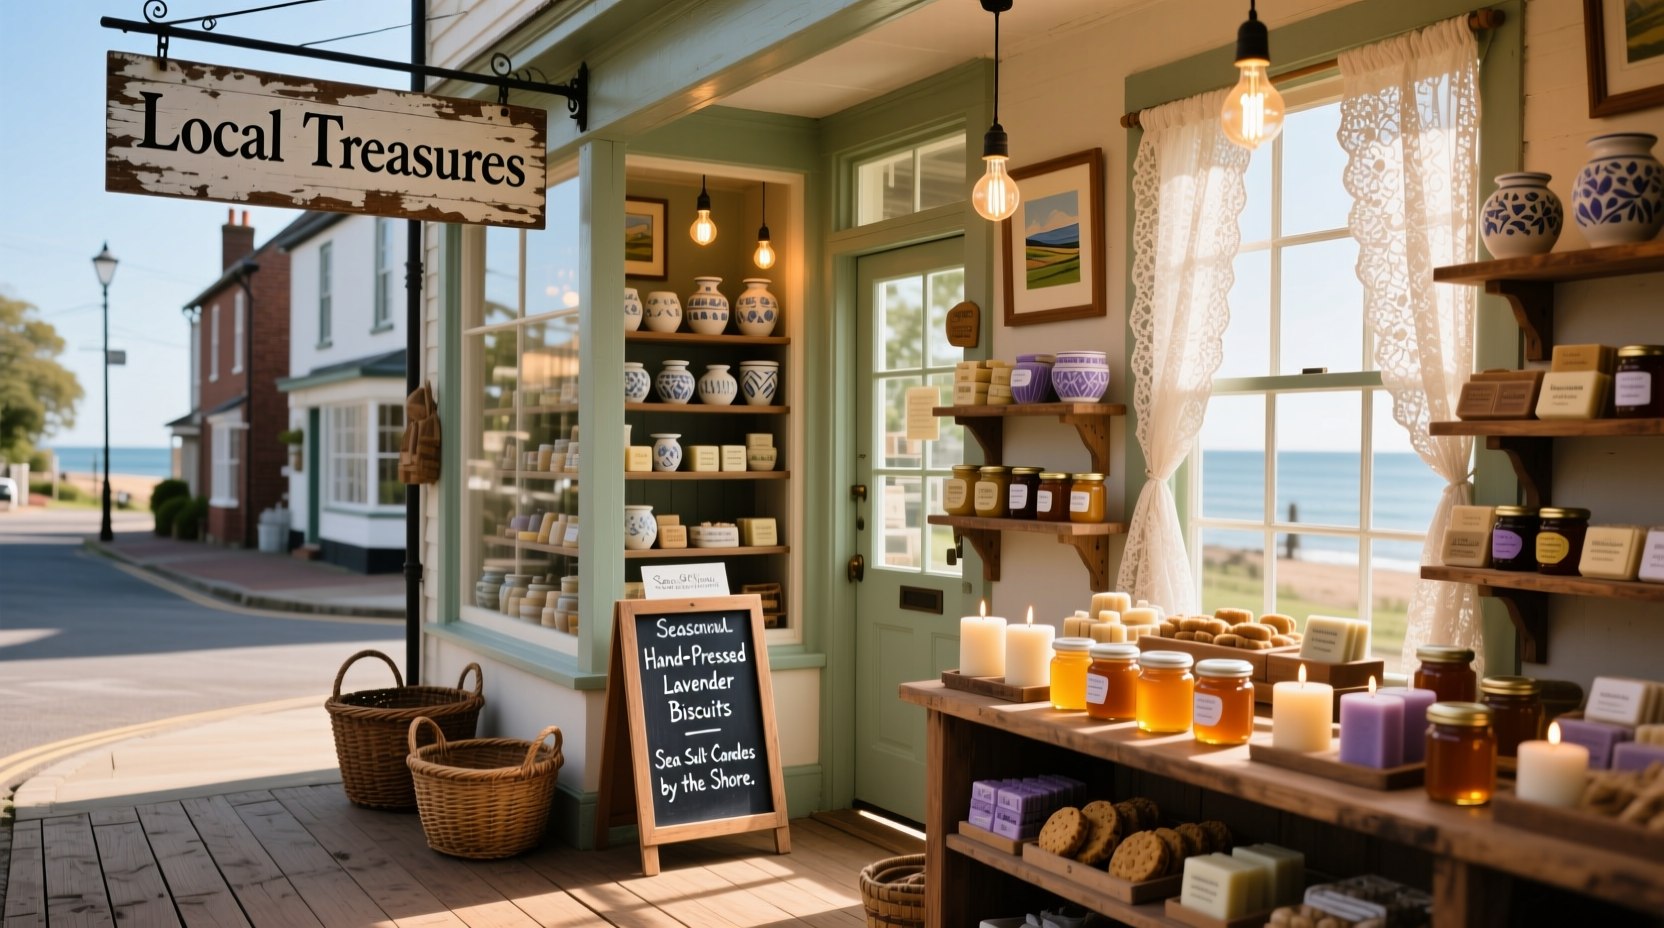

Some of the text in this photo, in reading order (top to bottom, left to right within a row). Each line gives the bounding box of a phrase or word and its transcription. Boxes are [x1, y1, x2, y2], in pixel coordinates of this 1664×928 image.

[137, 91, 526, 187] Local Treasures
[644, 641, 747, 670] Hand-Pressed
[663, 670, 735, 695] Lavender
[668, 700, 732, 723] Biscuits
[655, 748, 682, 770] Sea
[660, 767, 755, 803] by the Shore.
